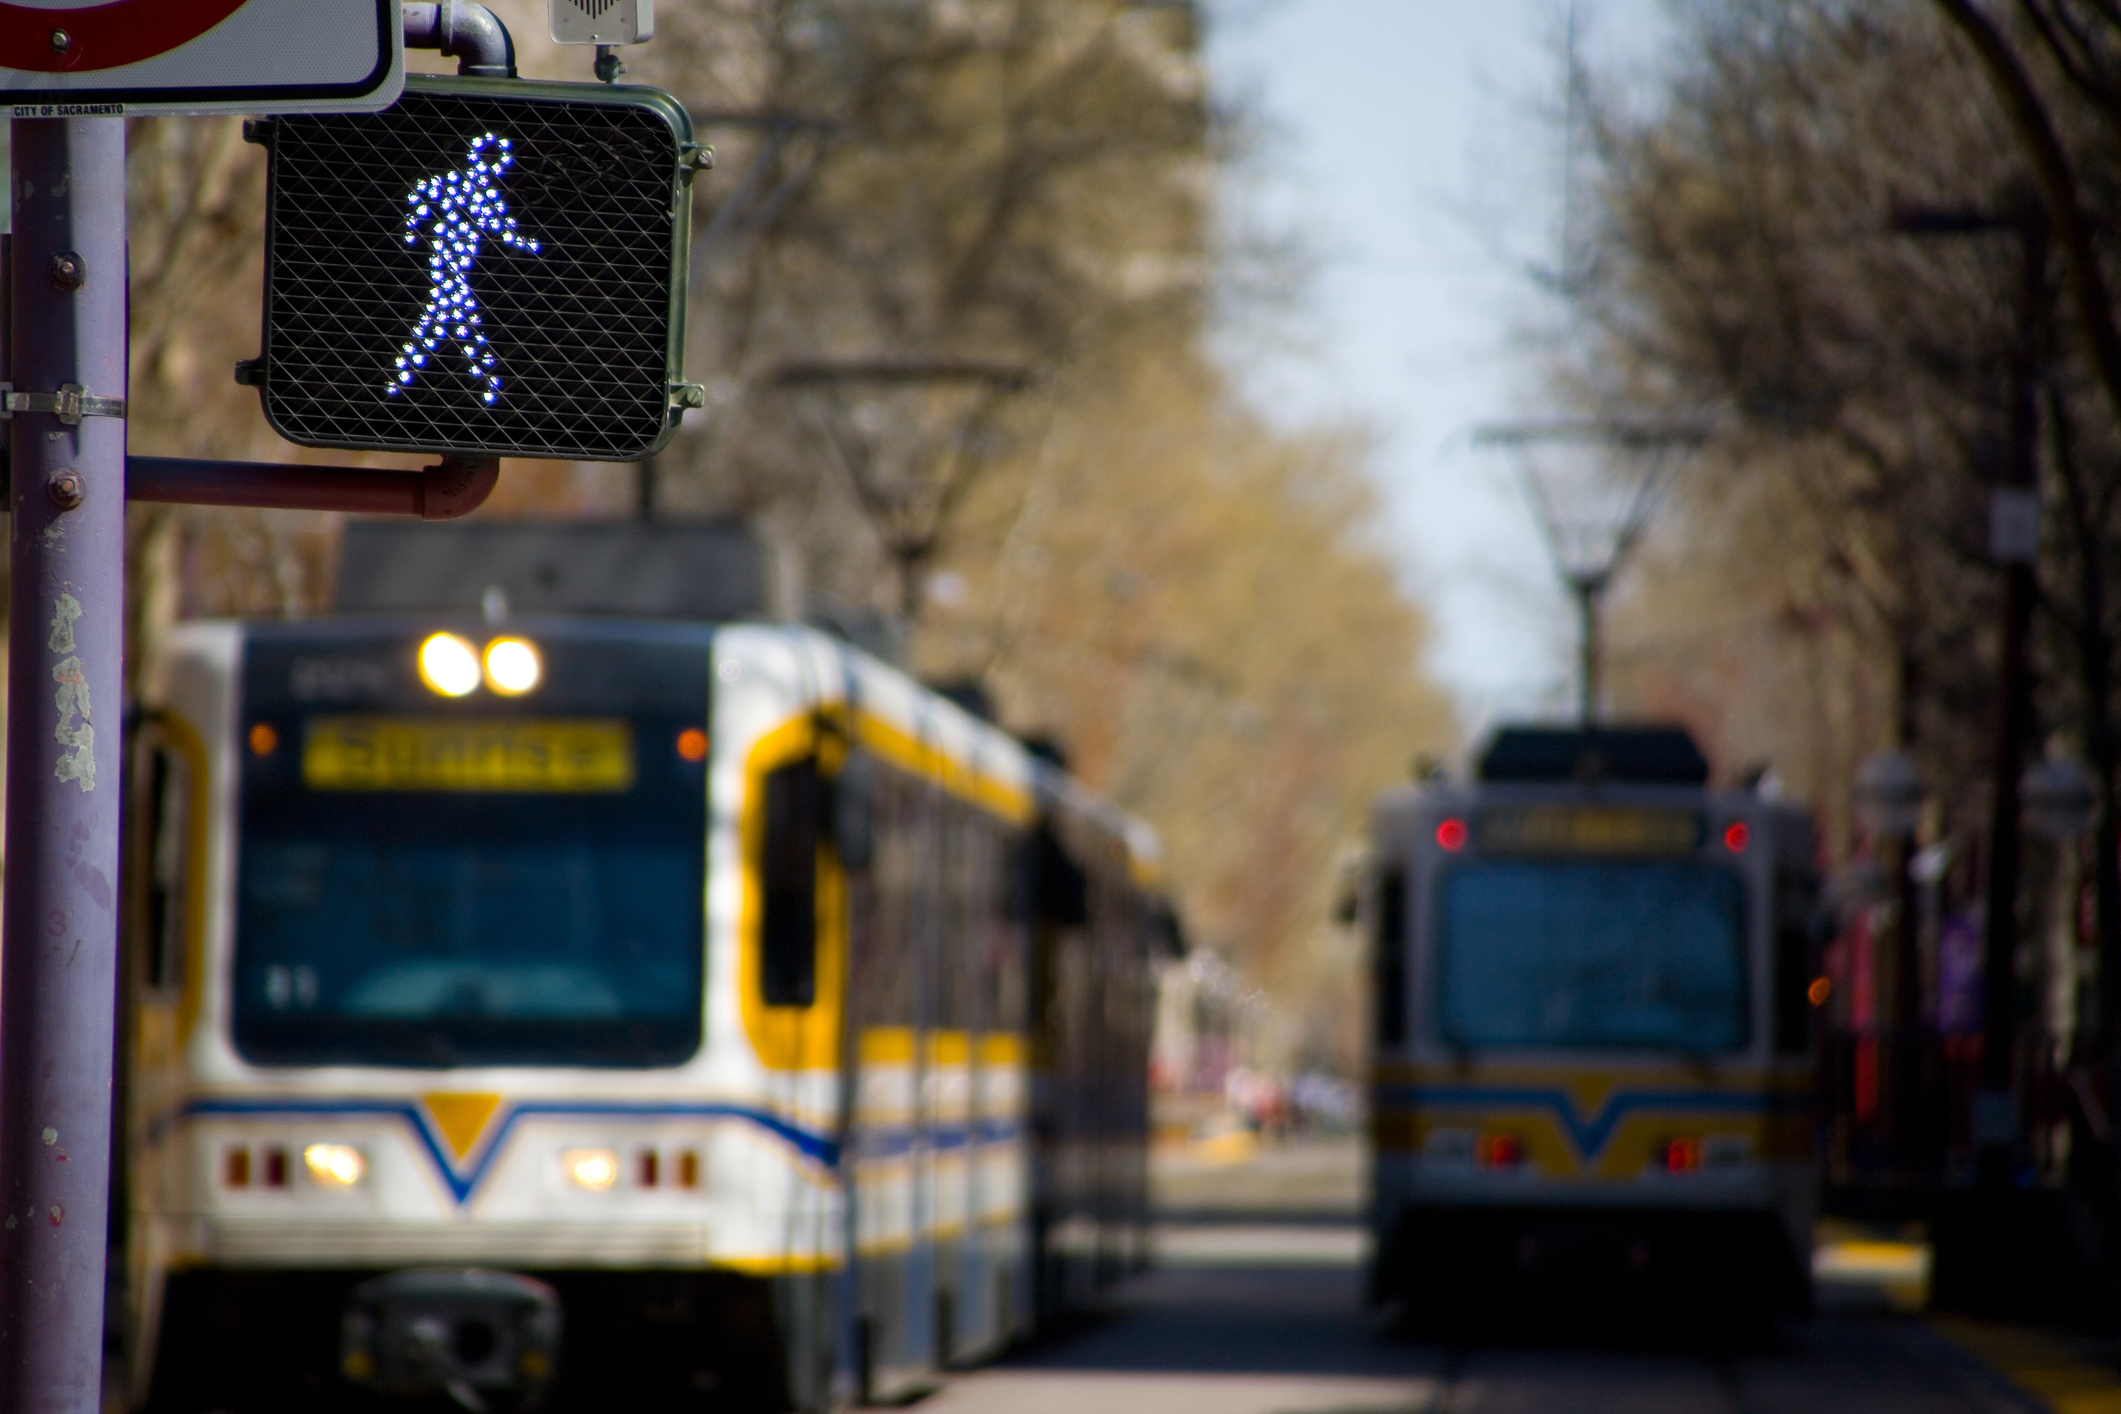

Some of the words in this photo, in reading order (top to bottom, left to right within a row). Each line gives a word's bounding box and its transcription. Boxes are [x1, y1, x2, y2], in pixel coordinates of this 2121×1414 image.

[14, 106, 37, 116] CITY
[41, 106, 54, 115] OF
[57, 104, 124, 116] SACRAMENTO
